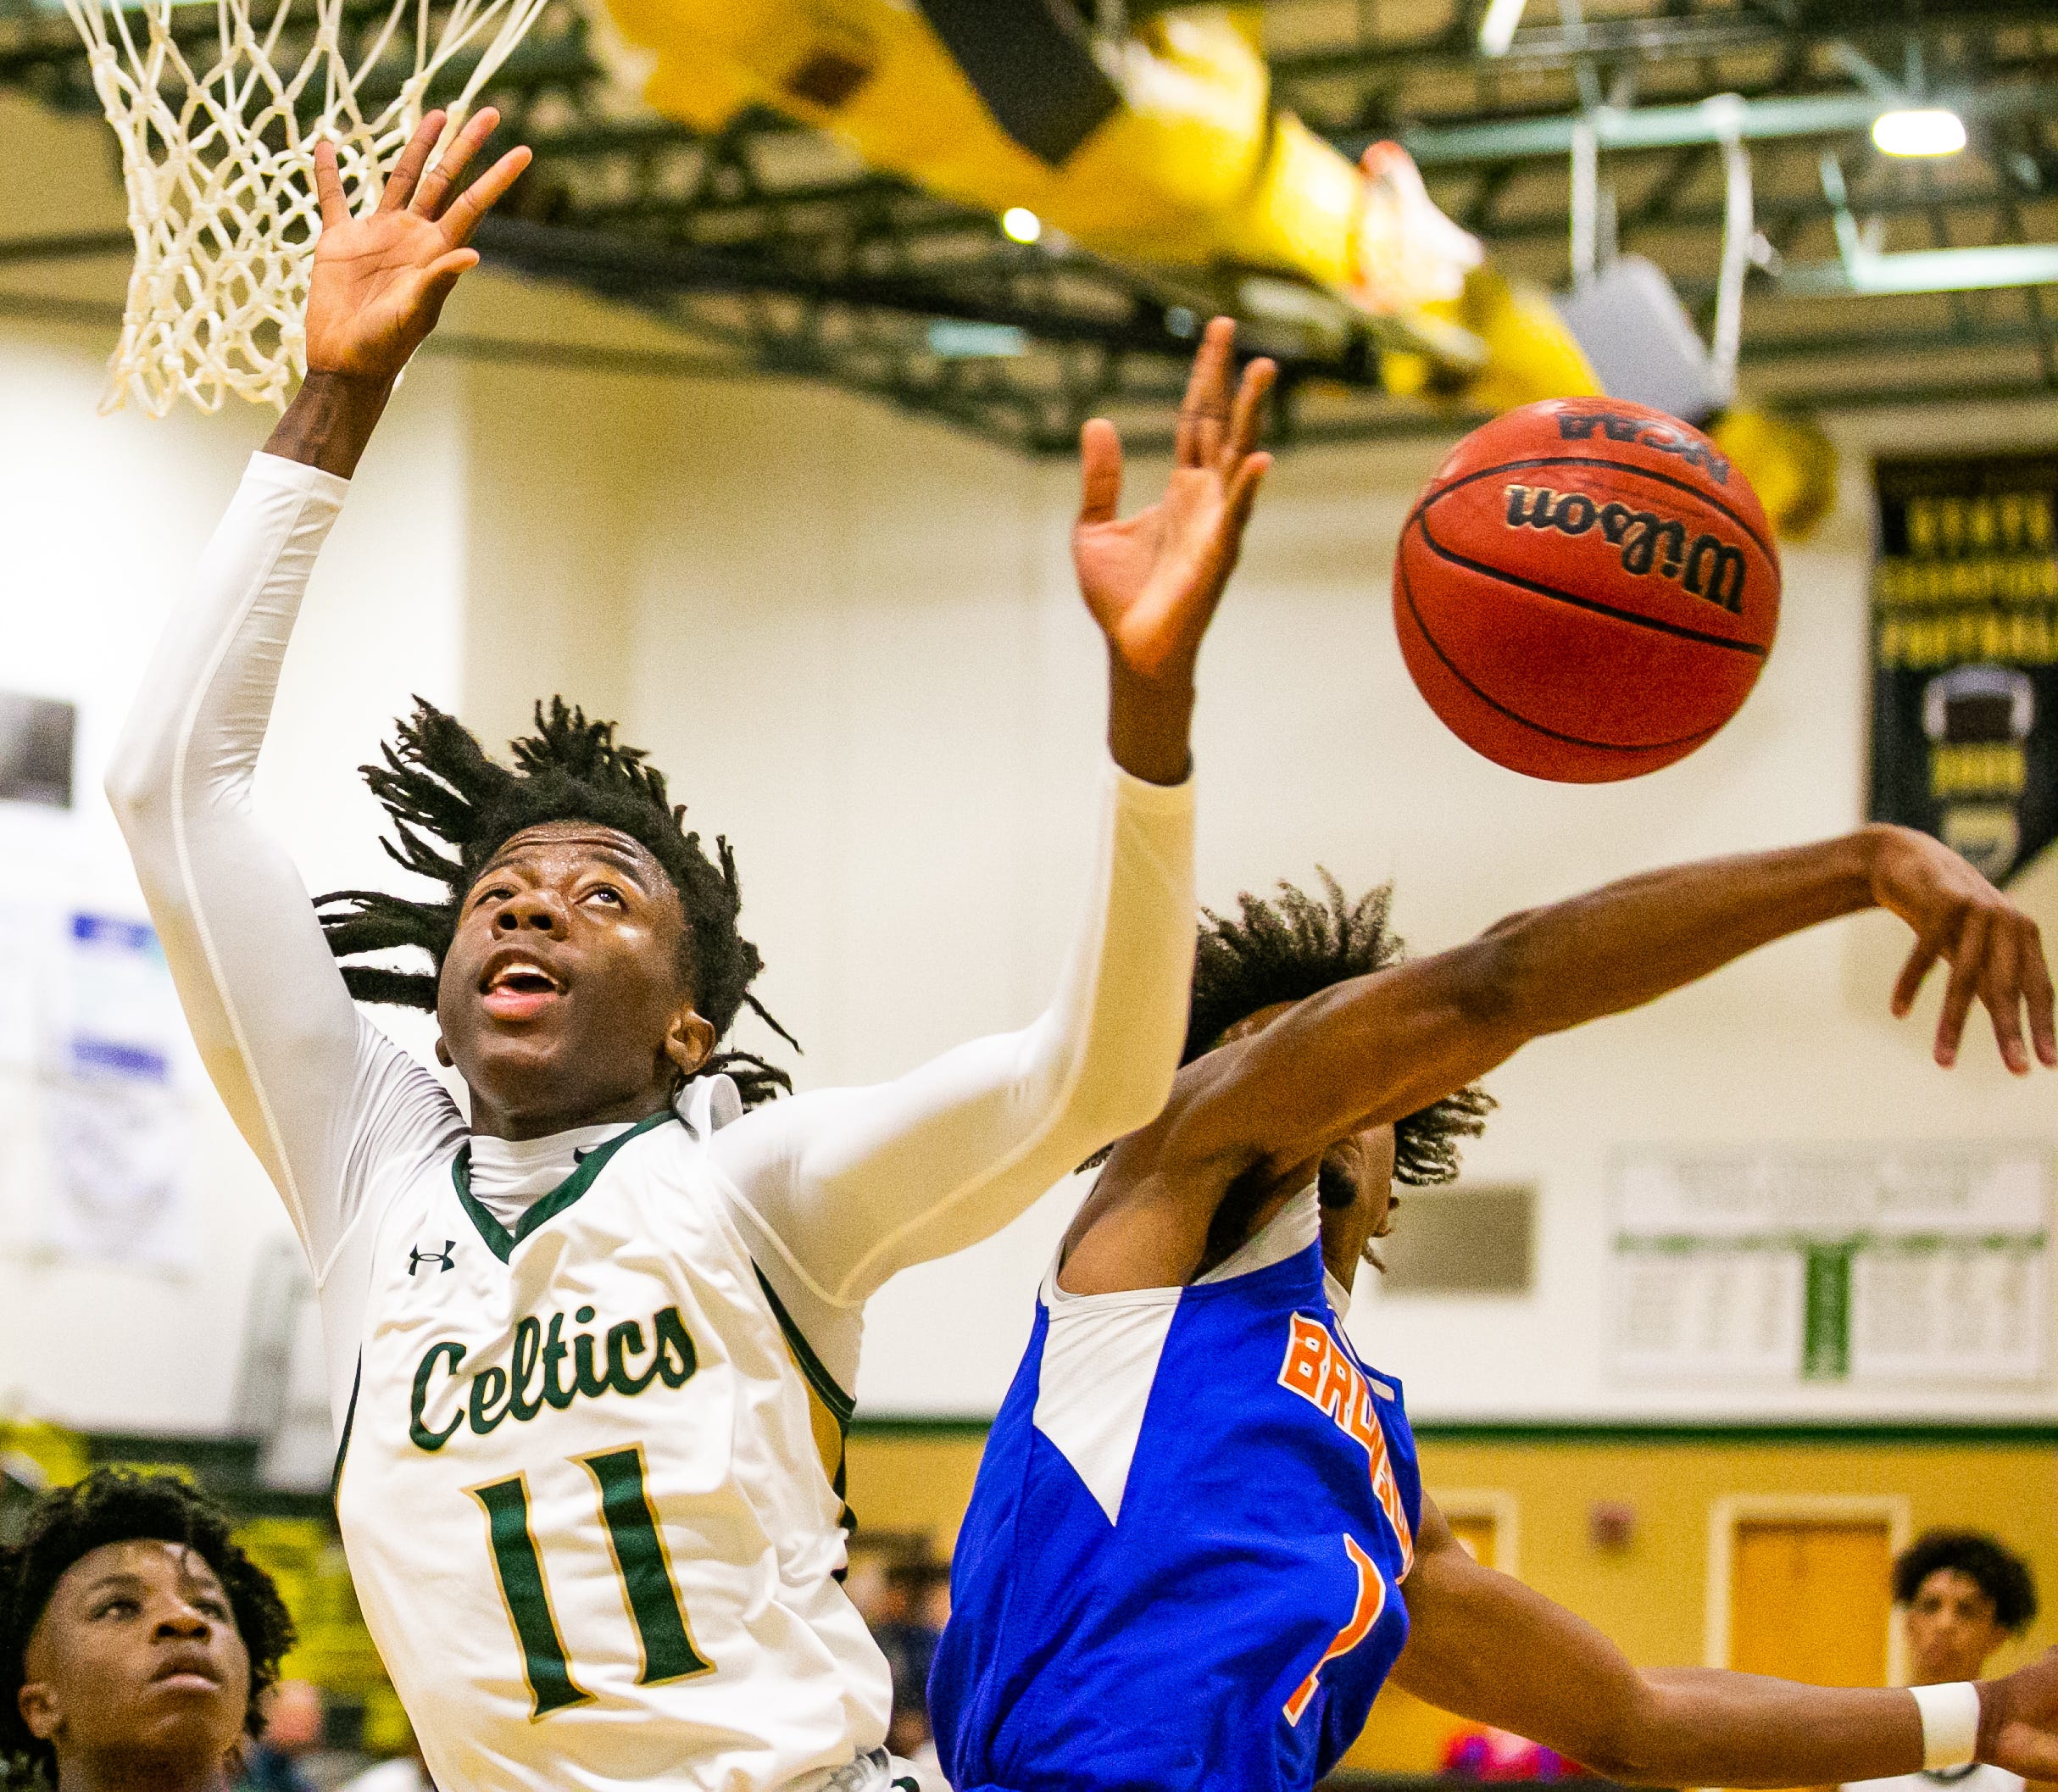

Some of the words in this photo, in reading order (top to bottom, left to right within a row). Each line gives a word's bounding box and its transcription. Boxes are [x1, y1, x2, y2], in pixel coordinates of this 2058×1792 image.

[1556, 412, 1731, 487] NCAA
[1505, 484, 1747, 615] Wilson
[408, 1304, 698, 1452] Celtics
[459, 1440, 717, 1724] 11
